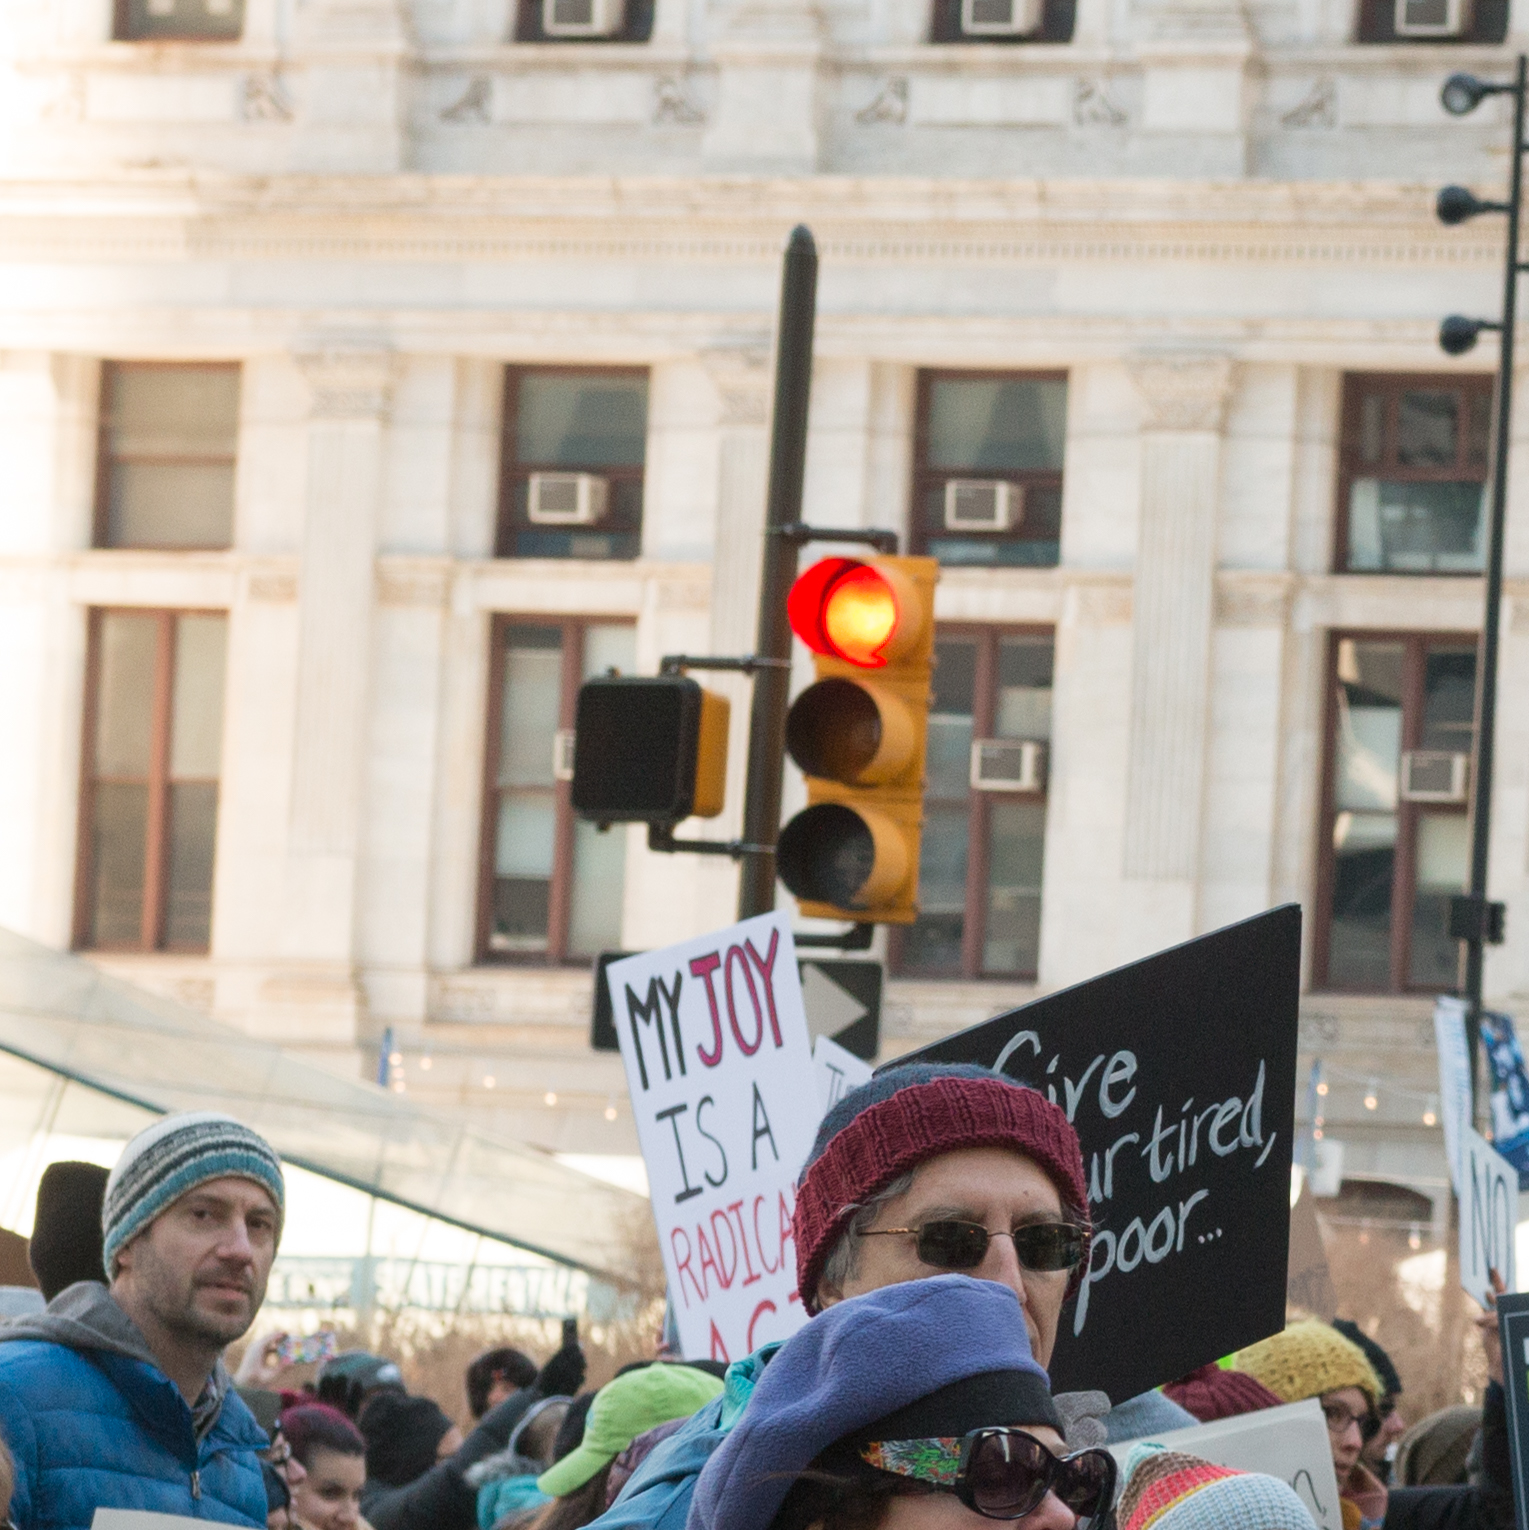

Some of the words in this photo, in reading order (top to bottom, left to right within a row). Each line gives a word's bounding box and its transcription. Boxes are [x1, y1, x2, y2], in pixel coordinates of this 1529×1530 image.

[624, 969, 687, 1091] MY
[688, 926, 783, 1067] JOY
[656, 1095, 728, 1204] IS
[752, 1079, 779, 1171] A
[1141, 1058, 1277, 1183] tired,
[671, 1181, 799, 1309] RADICA
